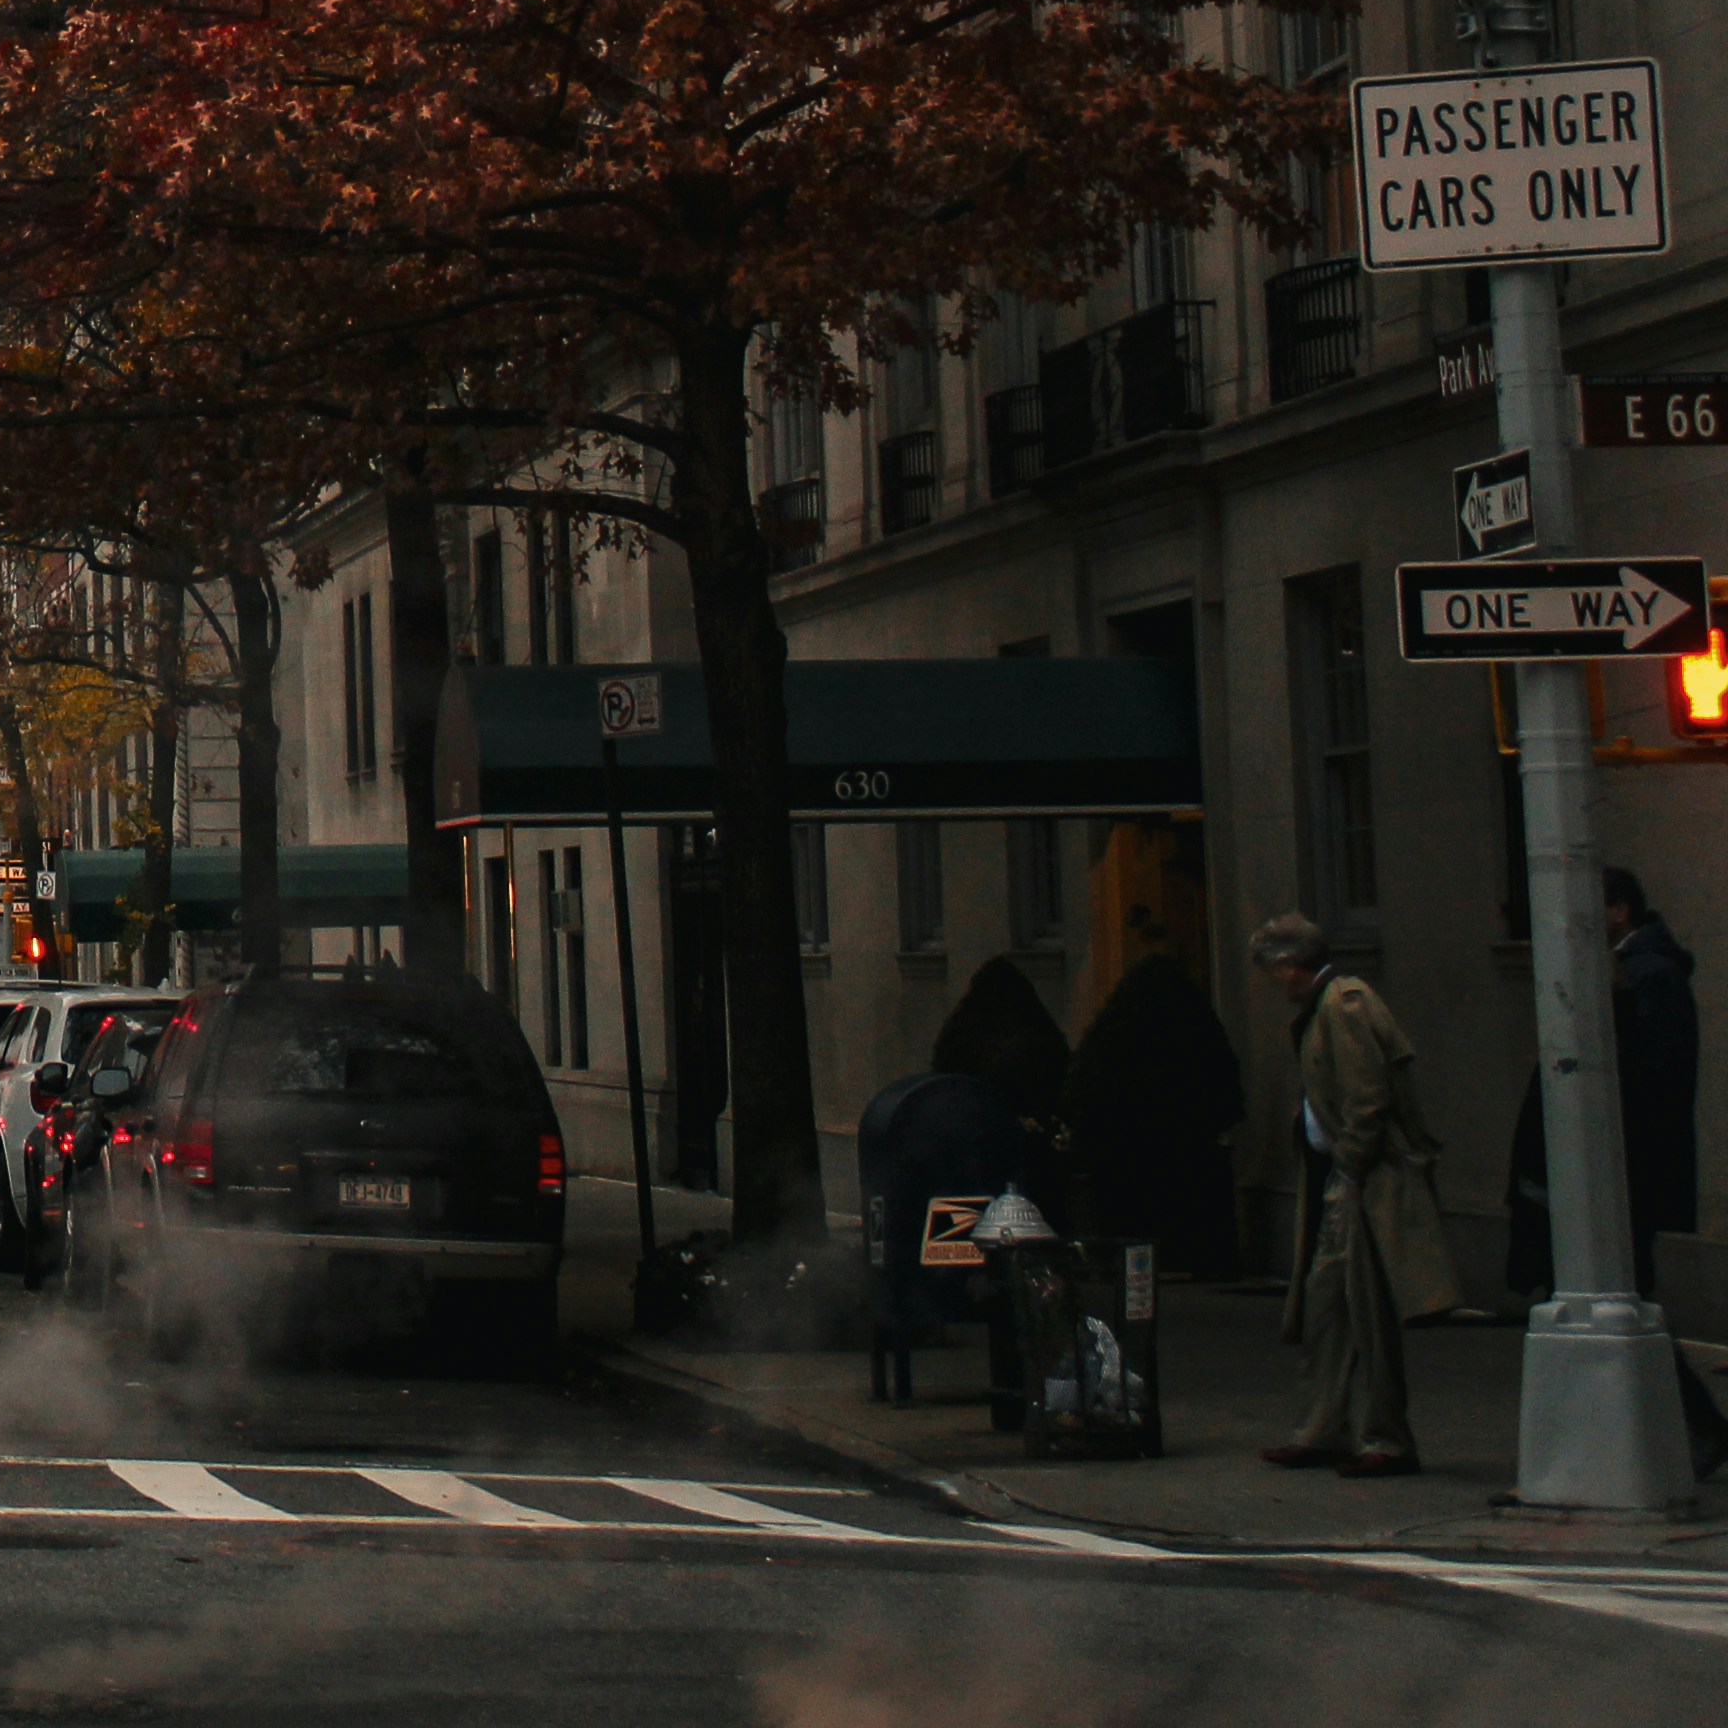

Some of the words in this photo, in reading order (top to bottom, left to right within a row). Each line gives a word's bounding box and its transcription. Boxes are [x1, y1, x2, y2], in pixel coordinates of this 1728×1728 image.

[1375, 90, 1638, 158] PASSENGER
[1380, 174, 1495, 232] CARS
[1527, 164, 1640, 221] ONLY
[1438, 345, 1473, 397] Park
[1625, 395, 1646, 439] E
[1666, 393, 1716, 438] 66
[1467, 490, 1493, 530] ONE
[1501, 481, 1523, 519] WAY
[1445, 592, 1532, 630] ONE
[1570, 590, 1660, 627] WAY
[835, 771, 889, 800] 630
